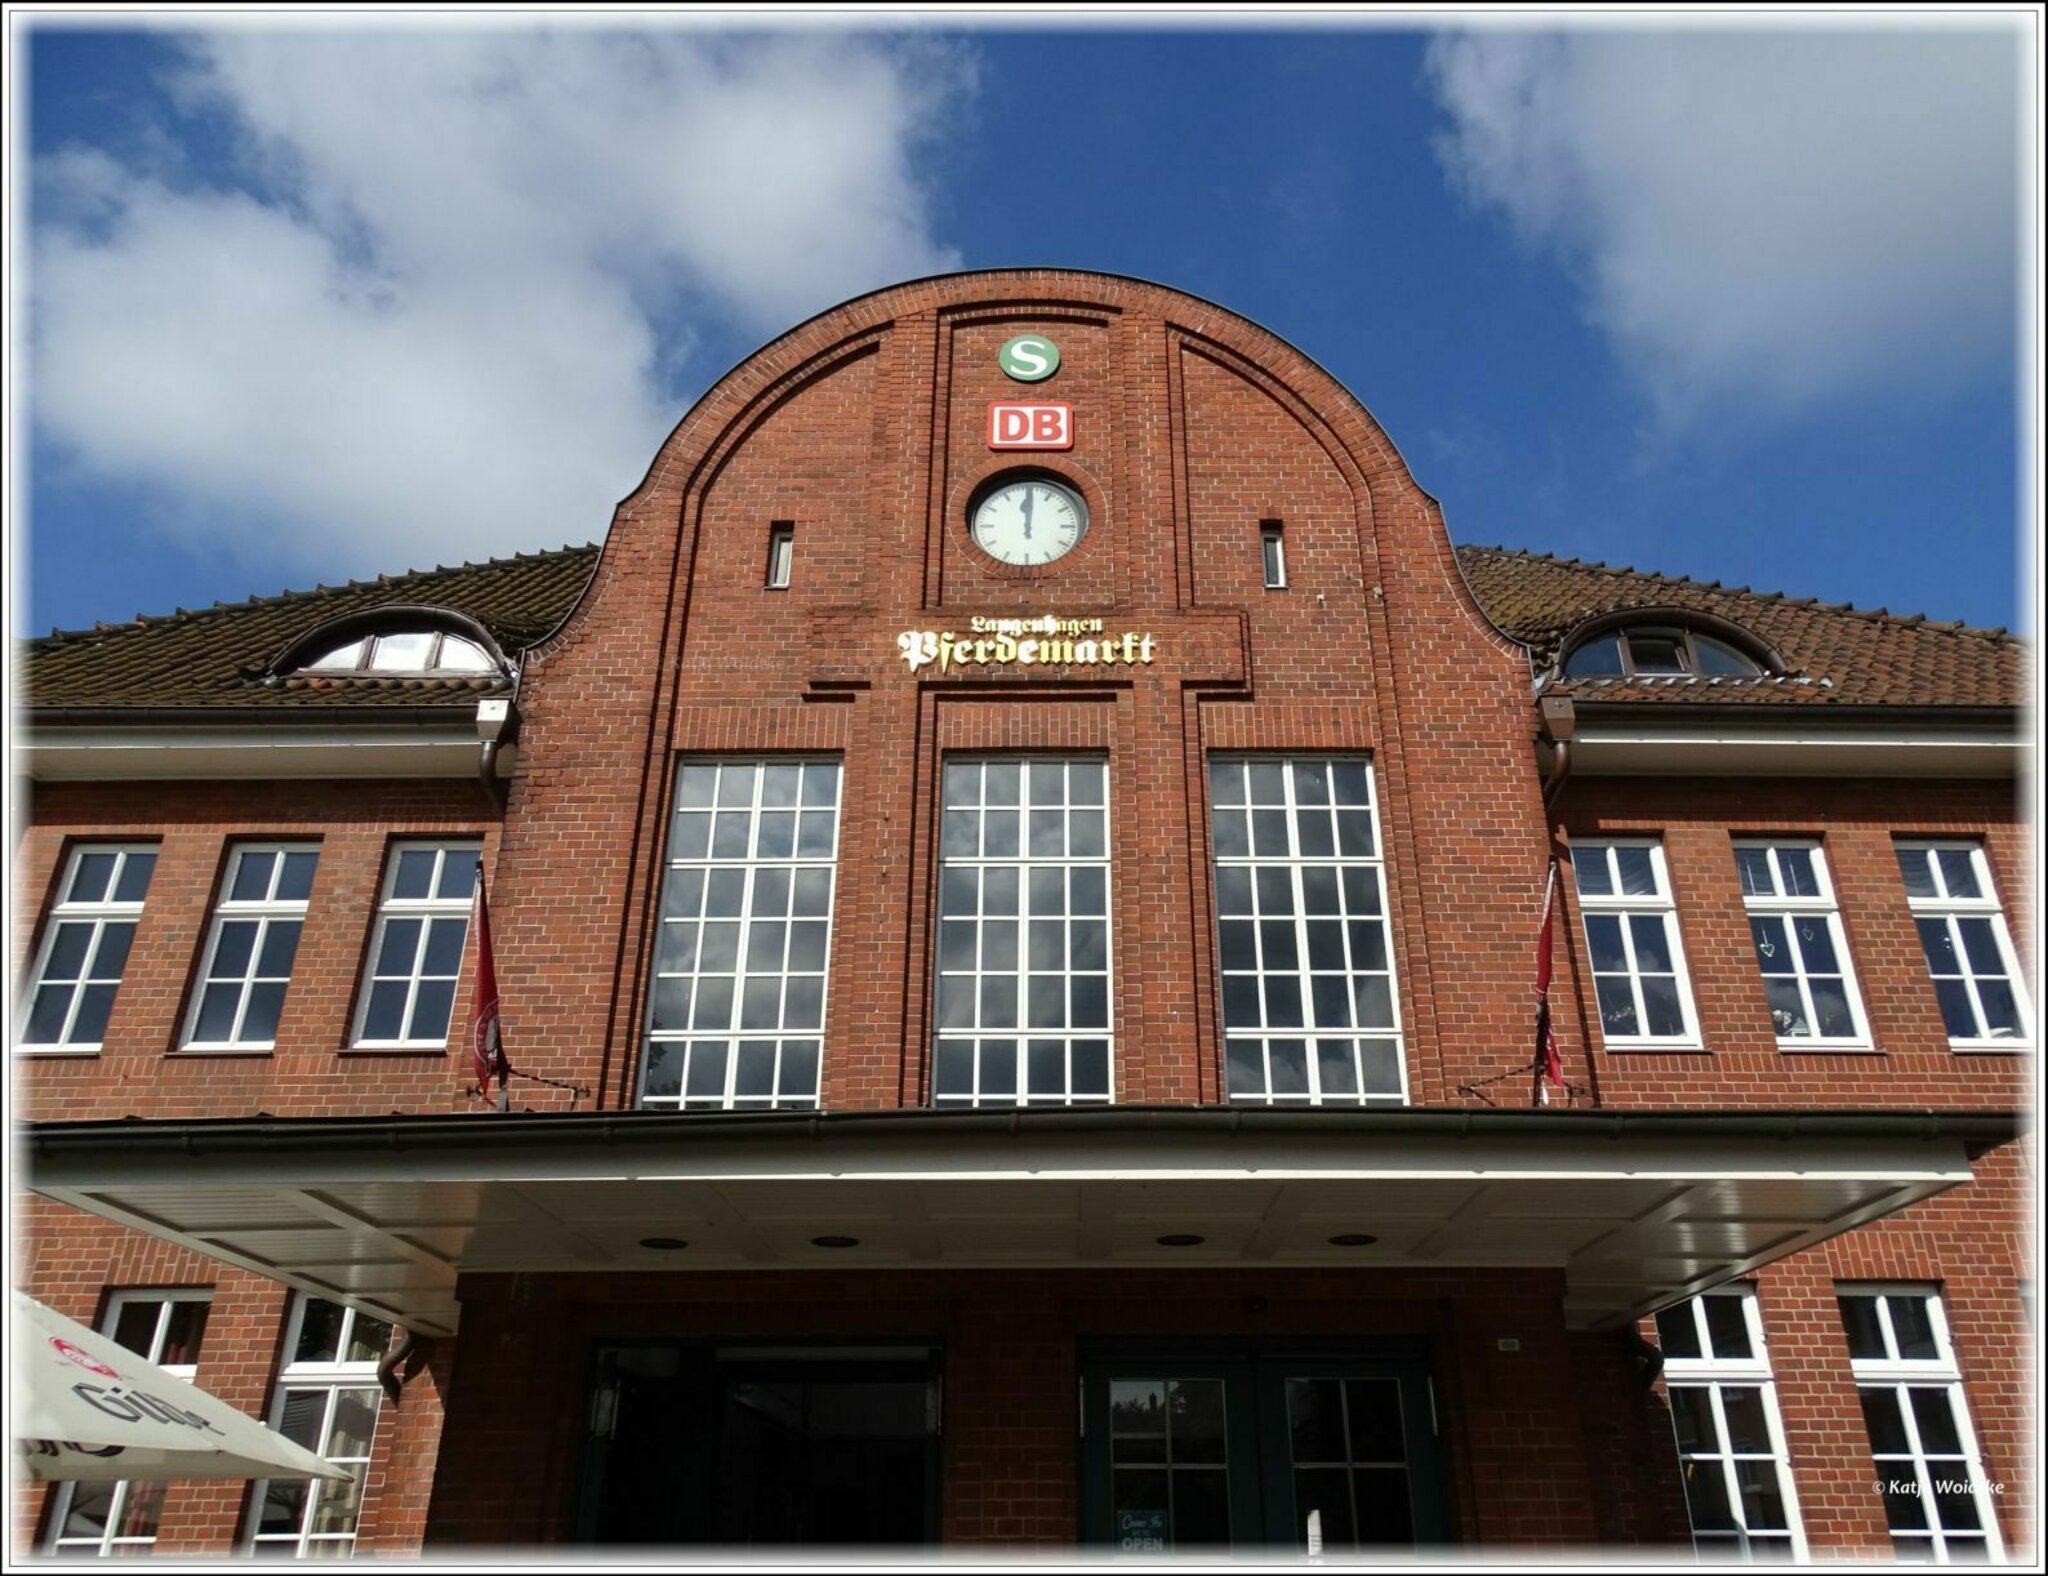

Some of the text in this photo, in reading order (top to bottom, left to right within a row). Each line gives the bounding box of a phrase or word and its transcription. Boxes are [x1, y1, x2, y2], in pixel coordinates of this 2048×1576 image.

[1010, 340, 1048, 377] S
[999, 409, 1063, 442] DB
[970, 615, 1103, 638] Langenhagen
[897, 630, 1156, 674] Pferdemarkt
[1121, 1537, 1163, 1551] OPEN
